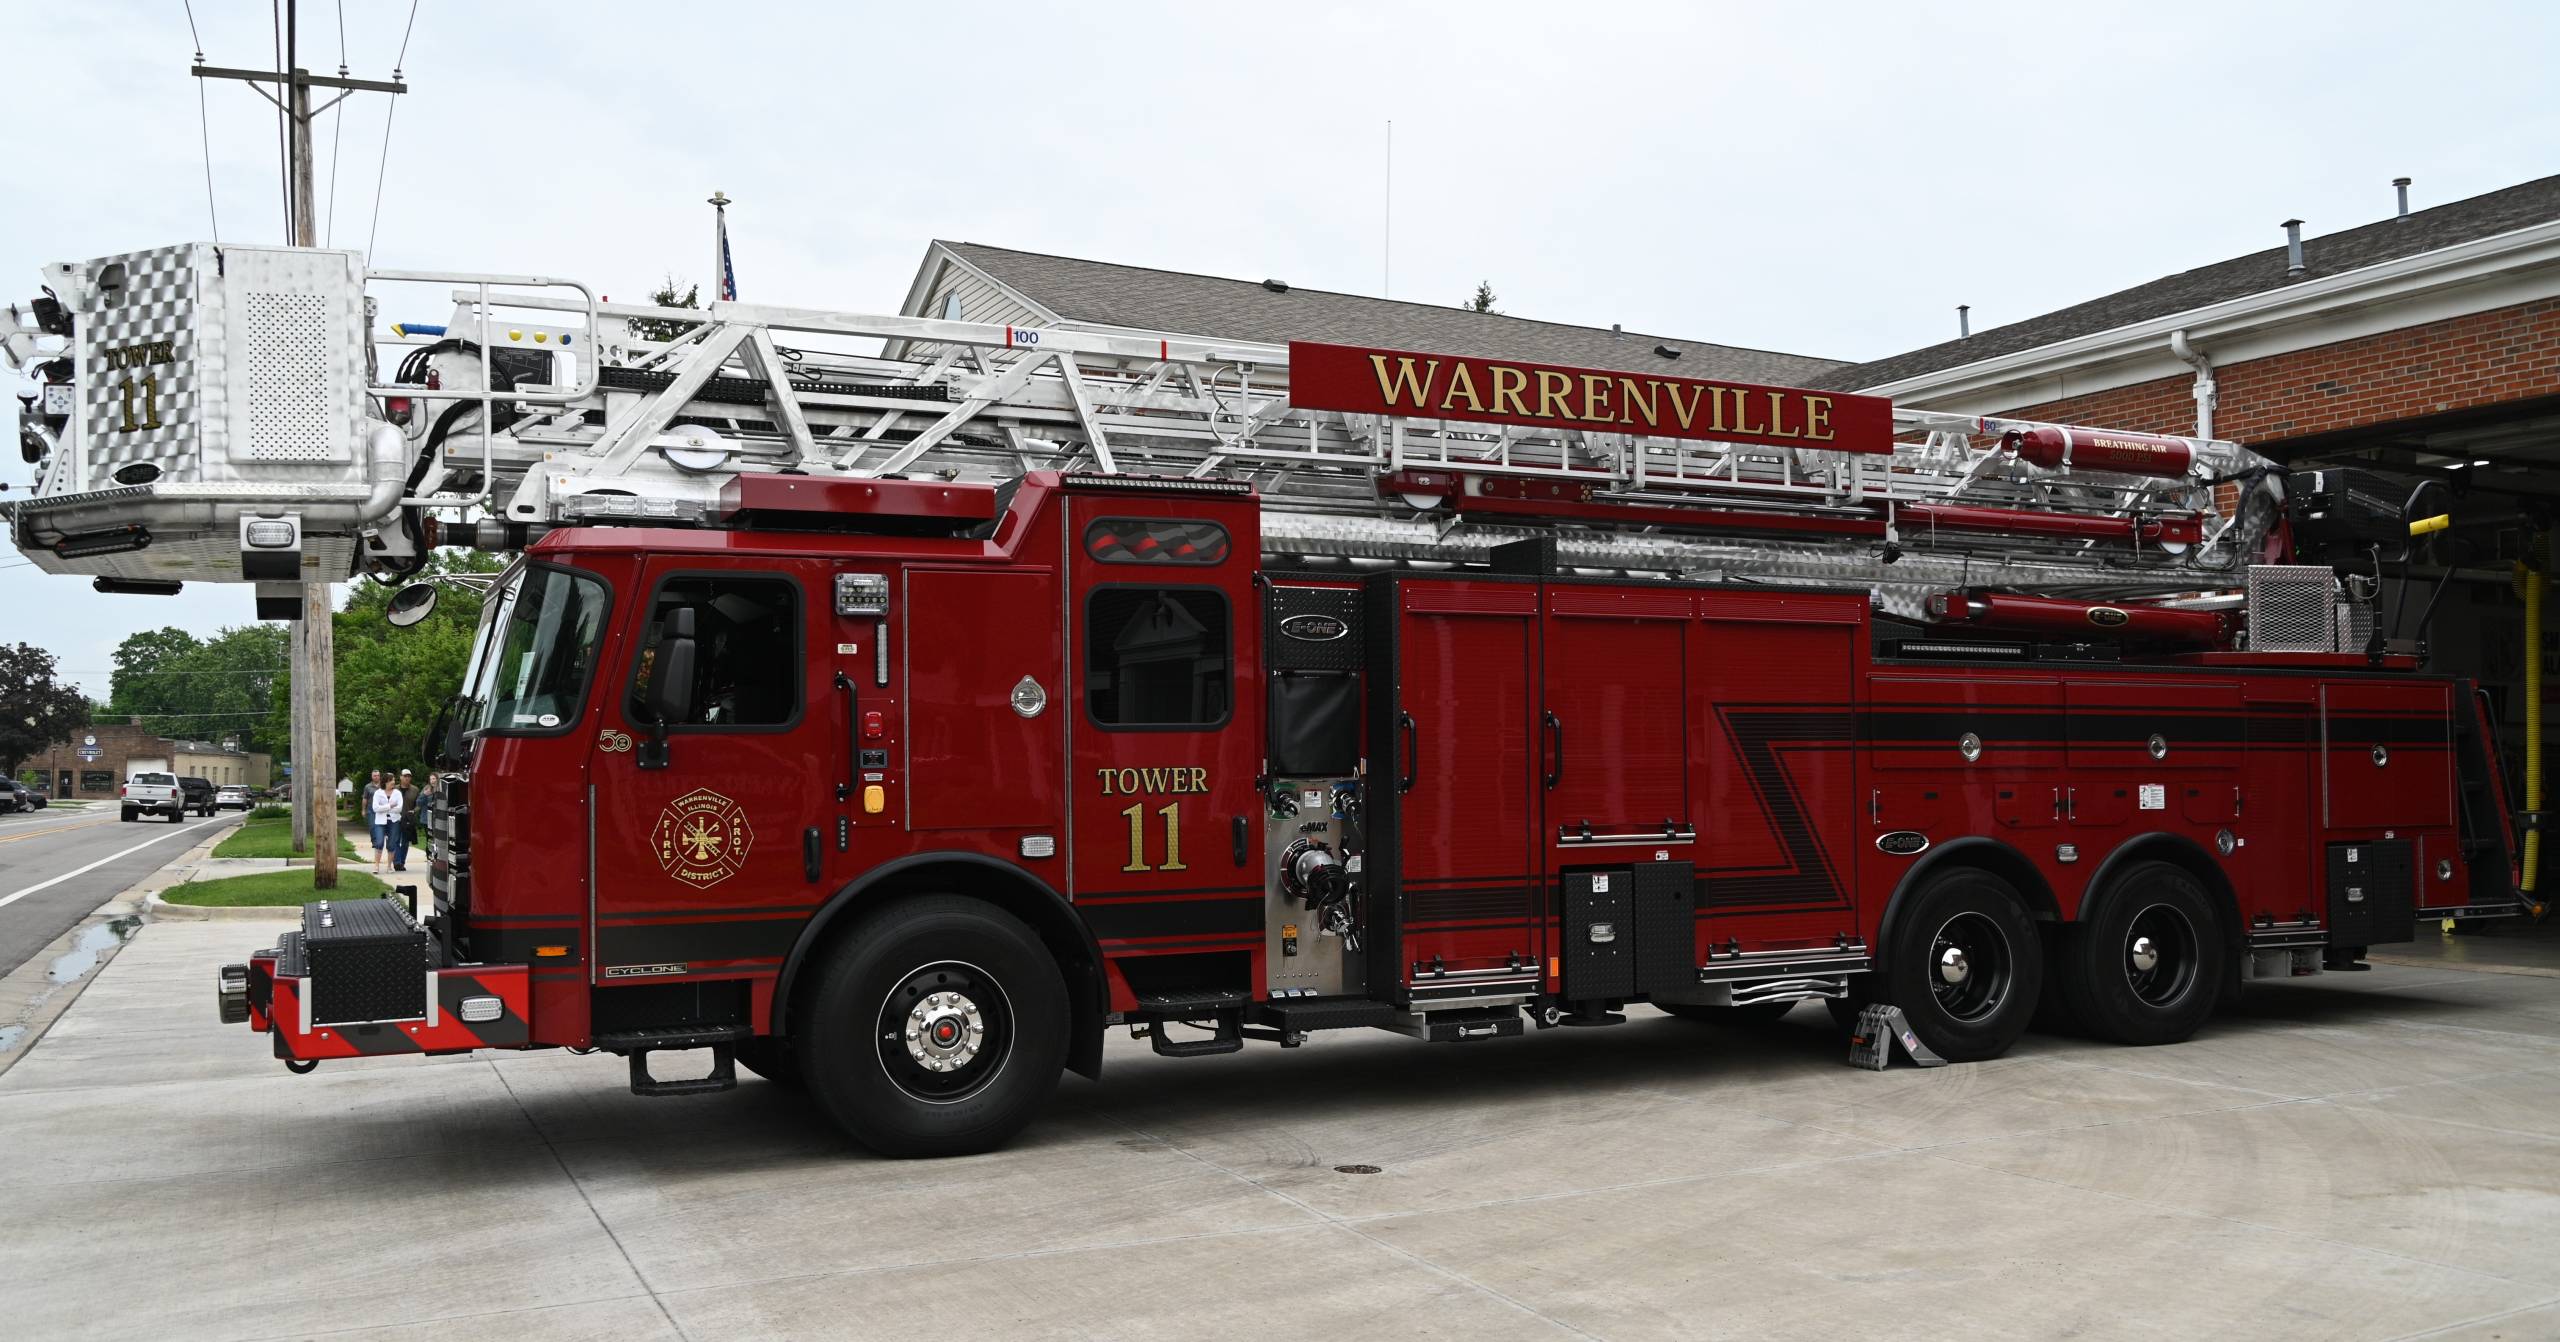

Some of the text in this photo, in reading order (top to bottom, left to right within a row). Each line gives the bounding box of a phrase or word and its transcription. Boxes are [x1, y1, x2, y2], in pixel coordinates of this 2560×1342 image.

[1013, 330, 1039, 344] 100
[104, 340, 175, 371] TOWER
[118, 372, 162, 434] 11
[1368, 354, 1836, 441] WARRENVILLE
[1984, 420, 1996, 431] 60
[2093, 438, 2167, 454] BREATHING AIR
[1291, 621, 1337, 634] E-ONE
[599, 729, 632, 752] 50
[1098, 766, 1209, 794] TOWER
[677, 795, 727, 808] WARRENVILLE
[687, 803, 718, 812] ILLINOIS
[1300, 822, 1328, 833] eMAX
[663, 820, 671, 859] FIRE
[733, 817, 743, 856] PROT.
[1121, 801, 1188, 872] 11
[681, 867, 723, 881] DISTRICT
[608, 965, 684, 976] CYCLONE
